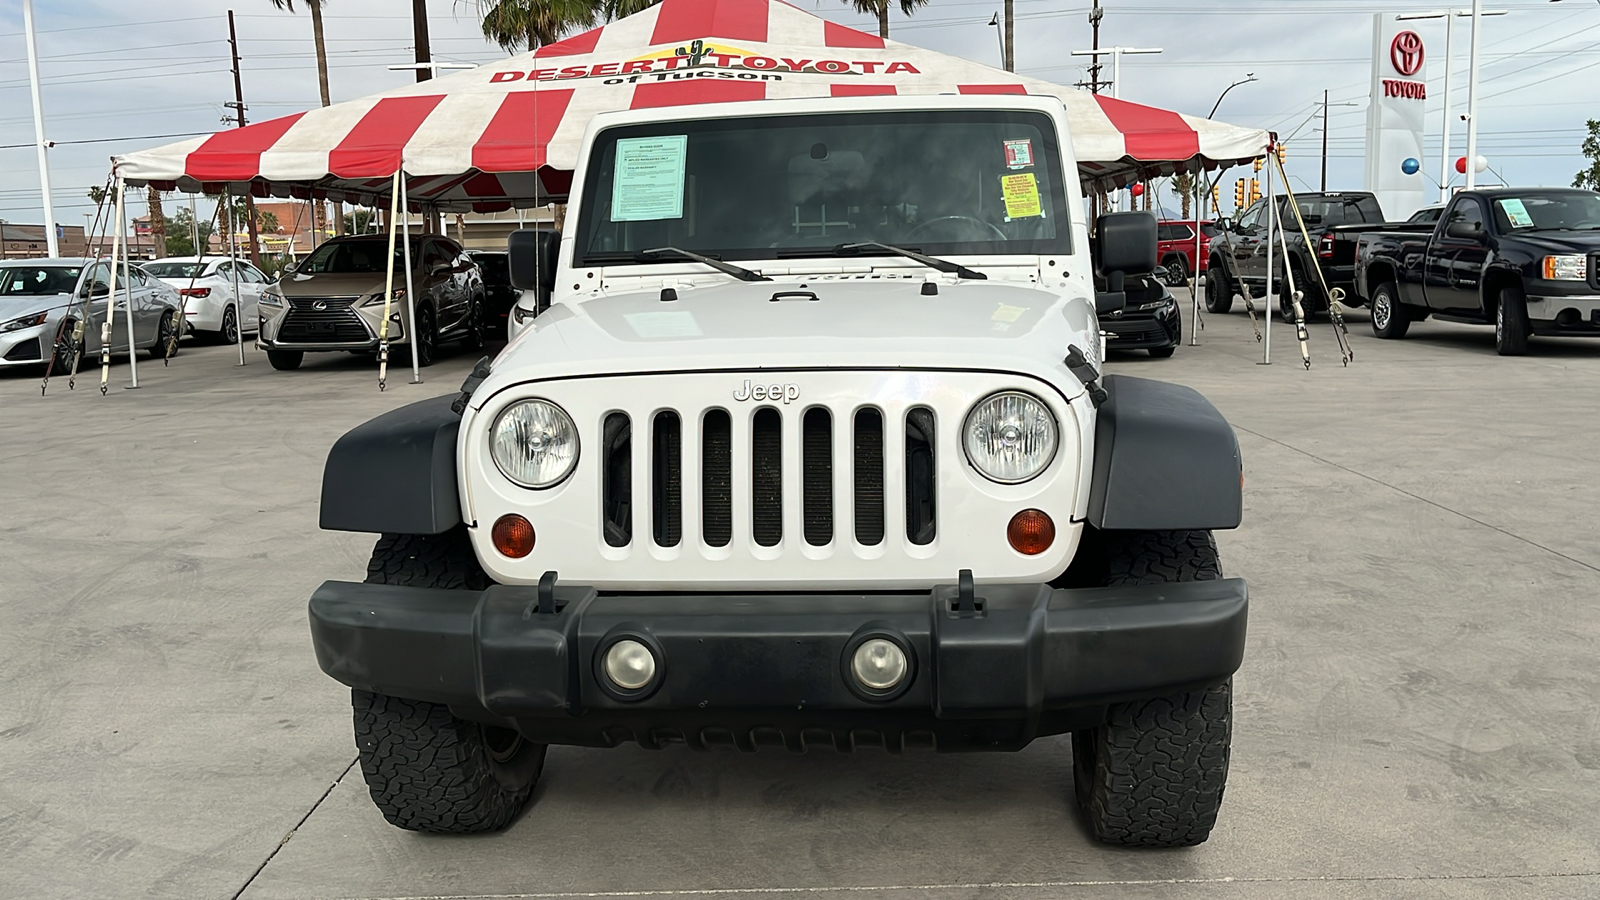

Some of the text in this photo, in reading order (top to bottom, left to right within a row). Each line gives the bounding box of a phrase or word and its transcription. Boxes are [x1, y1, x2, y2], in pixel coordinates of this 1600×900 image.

[489, 52, 921, 83] DESERT TOYOTA
[603, 71, 783, 85] of Tucson
[1382, 79, 1426, 100] TOYOTA
[733, 379, 800, 404] Jeep
